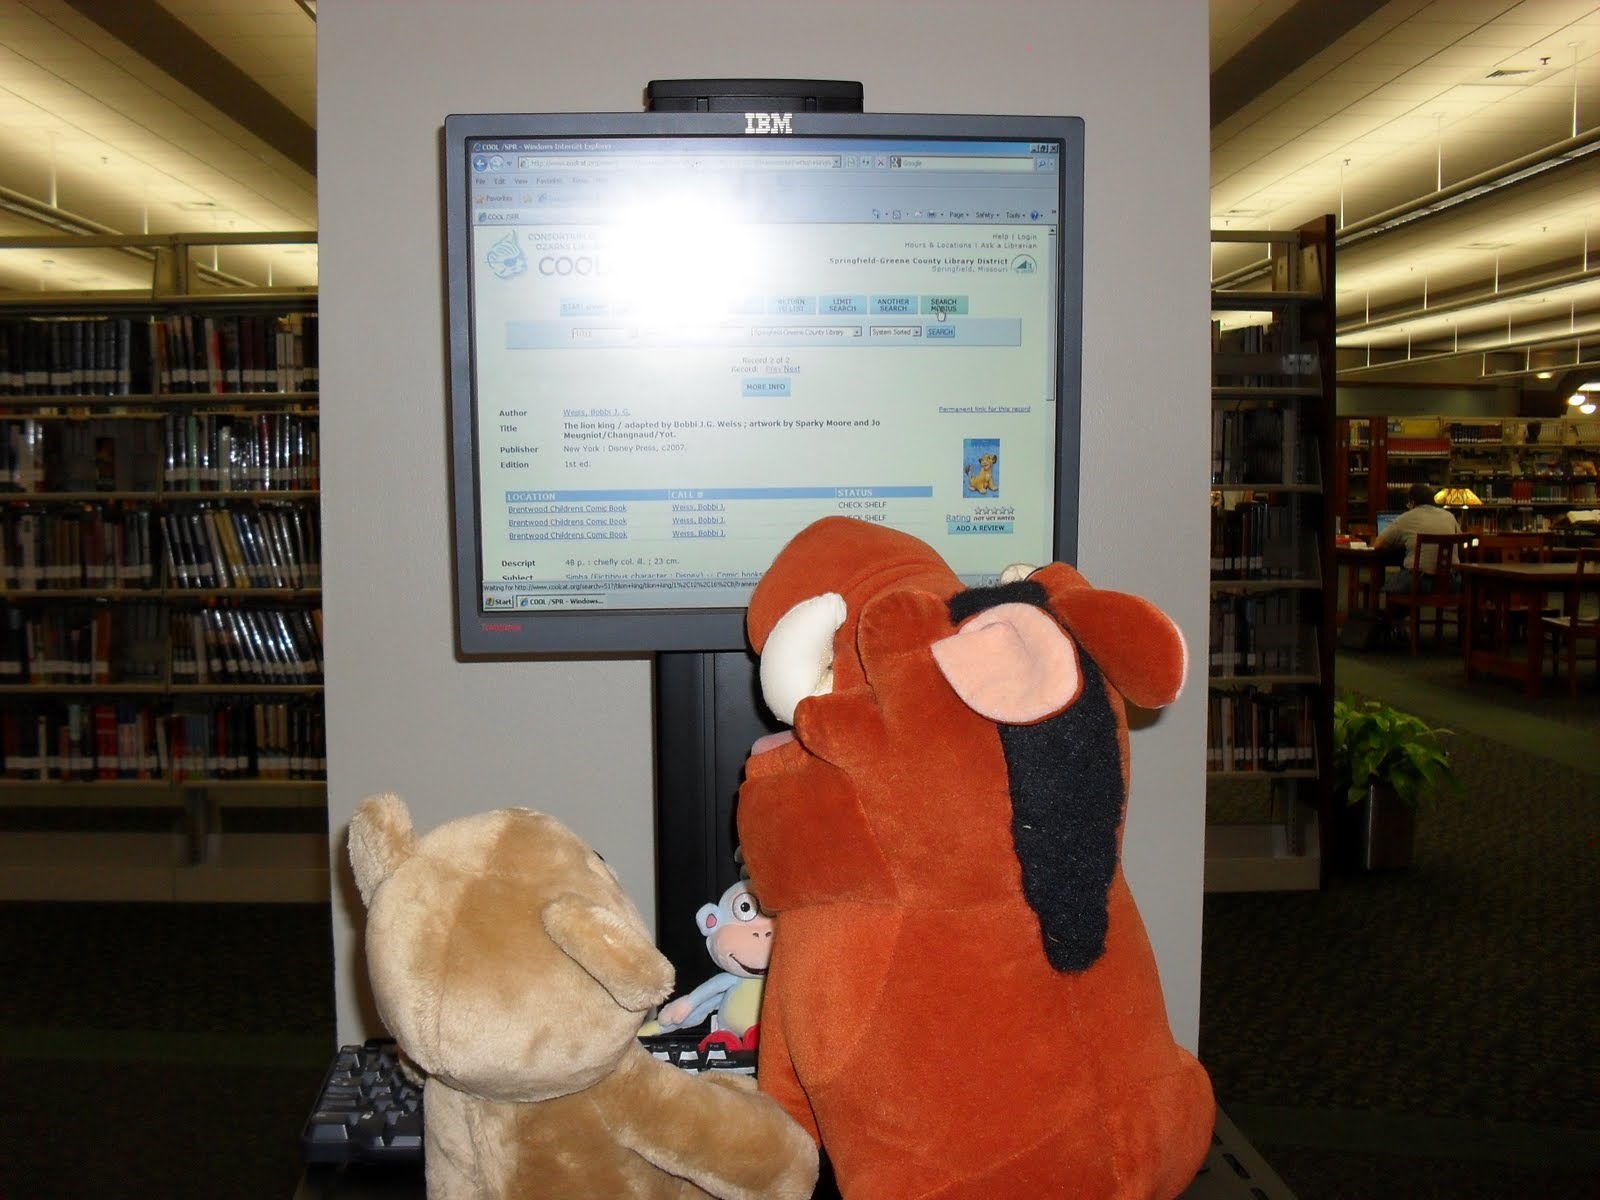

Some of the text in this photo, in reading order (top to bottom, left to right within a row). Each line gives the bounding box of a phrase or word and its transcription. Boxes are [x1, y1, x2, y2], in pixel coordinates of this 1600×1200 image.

[745, 113, 792, 134] IBM
[482, 143, 499, 151] COOL
[523, 143, 553, 151] Windows
[950, 211, 964, 219] Page
[976, 211, 995, 219] Safety
[992, 233, 1038, 242] Help Login
[904, 241, 927, 249] Hours
[936, 241, 972, 249] Locations
[1004, 241, 1038, 249] Librarian
[829, 256, 1008, 266] Springfield-Greene County Library District
[978, 265, 1008, 273] Missouri
[825, 328, 844, 337] Library
[872, 328, 911, 337] System Sorted
[928, 328, 953, 336] SEARCH
[784, 365, 801, 374] Next
[499, 409, 527, 417] Author
[499, 424, 518, 432] Title
[599, 421, 615, 431] king
[624, 421, 659, 431] adapted
[661, 421, 671, 430] by
[674, 420, 697, 428] Bobbi
[717, 420, 742, 428] Weiss
[749, 419, 781, 427] artwork
[783, 419, 793, 429] by
[796, 419, 824, 428] Sparky
[826, 419, 851, 427] Moore
[853, 419, 869, 427] and
[871, 419, 881, 427] Jo
[563, 430, 677, 441] Meugniot/Changnaud/Yot.
[500, 445, 539, 454] Publisher
[608, 444, 634, 453] Disney
[500, 461, 529, 469] Edition
[507, 492, 556, 501] LOCATION
[671, 491, 694, 499] CALL
[837, 488, 873, 497] STATUS
[508, 505, 548, 514] Brentwood
[550, 505, 584, 513] Childrens
[585, 505, 607, 513] Comic
[609, 505, 627, 513] Book
[698, 503, 719, 511] Bobbi
[838, 501, 863, 509] CHECK
[864, 501, 887, 509] SHELF
[508, 519, 548, 528] Brentwood
[550, 518, 584, 527] Childrens
[585, 518, 607, 527] Comic
[609, 518, 627, 526] Book
[698, 516, 719, 524] Bobbi
[864, 514, 887, 522] SHELF
[946, 514, 971, 523] Rating
[509, 532, 549, 541] Brentwood
[550, 532, 584, 540] Childrens
[586, 532, 607, 540] Comic
[609, 531, 628, 539] Book
[698, 529, 719, 538] Bobbi
[501, 560, 536, 568] Descript
[577, 560, 585, 568] p.
[594, 558, 619, 567] chiefly
[484, 584, 505, 592] Waiting
